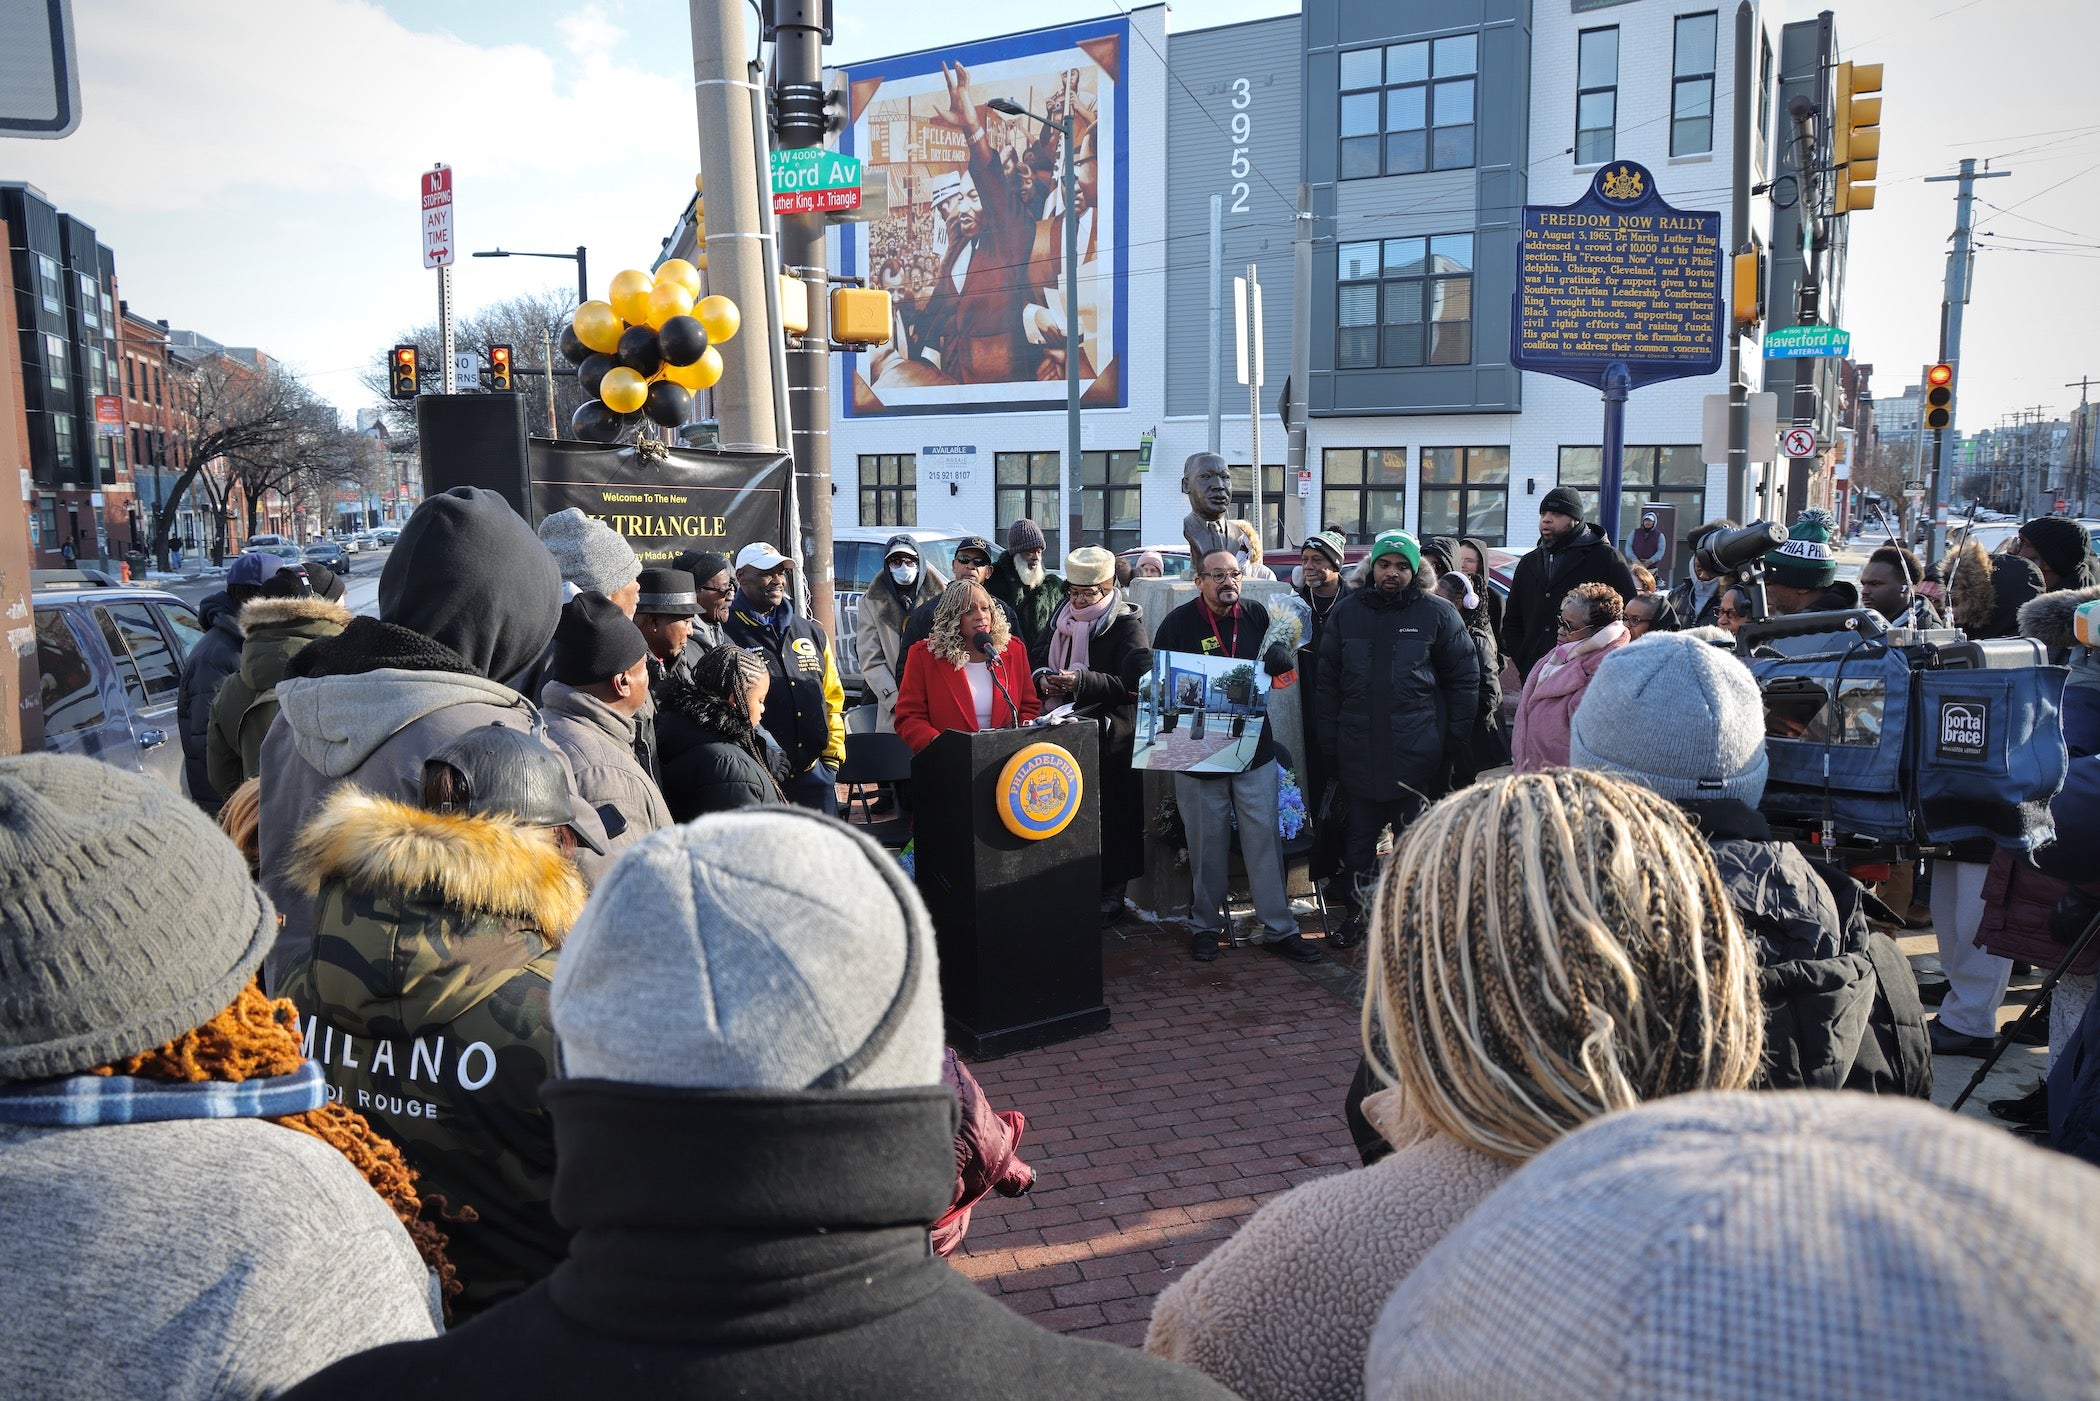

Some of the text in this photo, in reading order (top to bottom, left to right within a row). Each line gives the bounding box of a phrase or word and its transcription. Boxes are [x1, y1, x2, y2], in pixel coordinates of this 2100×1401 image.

[930, 128, 968, 146] CLEARVIE
[1231, 78, 1250, 213] 3952
[780, 152, 790, 163] W
[792, 151, 816, 160] 4000
[931, 149, 942, 161] DRY
[431, 172, 442, 192] NO
[771, 161, 856, 188] rford Av
[424, 189, 451, 208] STOPPING
[774, 196, 793, 209] uther
[796, 194, 814, 211] King,
[827, 191, 856, 208] Triangle
[428, 211, 446, 227] ANY
[1540, 214, 1705, 230] FREEDOM NOW RALLY
[428, 229, 448, 244] TIME
[1526, 229, 1538, 238] On
[1542, 230, 1575, 241] August
[1615, 232, 1627, 240] Dr.
[1631, 232, 1659, 242] Martin
[1664, 234, 1694, 243] Luther
[1697, 234, 1716, 246] King
[1525, 241, 1570, 250] addressed
[1585, 243, 1612, 251] crowd
[1616, 243, 1628, 252] of
[1630, 244, 1657, 253] 10,000
[1673, 245, 1688, 254] this
[1693, 246, 1716, 254] inter-
[1525, 253, 1560, 261] section.
[1563, 253, 1577, 261] His
[1655, 256, 1674, 264] tour
[1692, 257, 1716, 266] Phila-
[1525, 263, 1715, 277] delphia, Chicago, Cleveland, and Boston
[1560, 276, 1600, 285] gratitude
[1605, 276, 1619, 284] for
[1623, 279, 1657, 287] support
[1661, 278, 1684, 288] given
[1702, 279, 1714, 288] his
[1524, 285, 1714, 299] Southern Christian Leadership Conference.
[1524, 296, 1713, 310] King brought his message into northern
[1524, 307, 1713, 322] Black neighborhoods, supporting local
[1524, 319, 1712, 332] civil rights efforts and raising funds.
[1524, 329, 1538, 338] His
[1541, 330, 1559, 340] goal
[1594, 332, 1632, 342] empower
[1636, 332, 1648, 340] the
[1652, 332, 1691, 342] formation
[1695, 334, 1705, 342] of
[1765, 334, 1848, 348] Haverford Av
[1523, 340, 1558, 349] coalition
[1576, 341, 1608, 350] address
[1612, 342, 1631, 351] their
[458, 374, 476, 382] RNS
[602, 492, 687, 504] Welcome To The New
[612, 515, 726, 537] TRIANGLE
[645, 552, 666, 560] Made
[1946, 715, 1980, 730] porta
[1945, 729, 1980, 744] brace
[1010, 756, 1075, 794] PHILADELPHIA
[295, 1015, 497, 1091] MILANO
[358, 1089, 438, 1120] ROUGE
